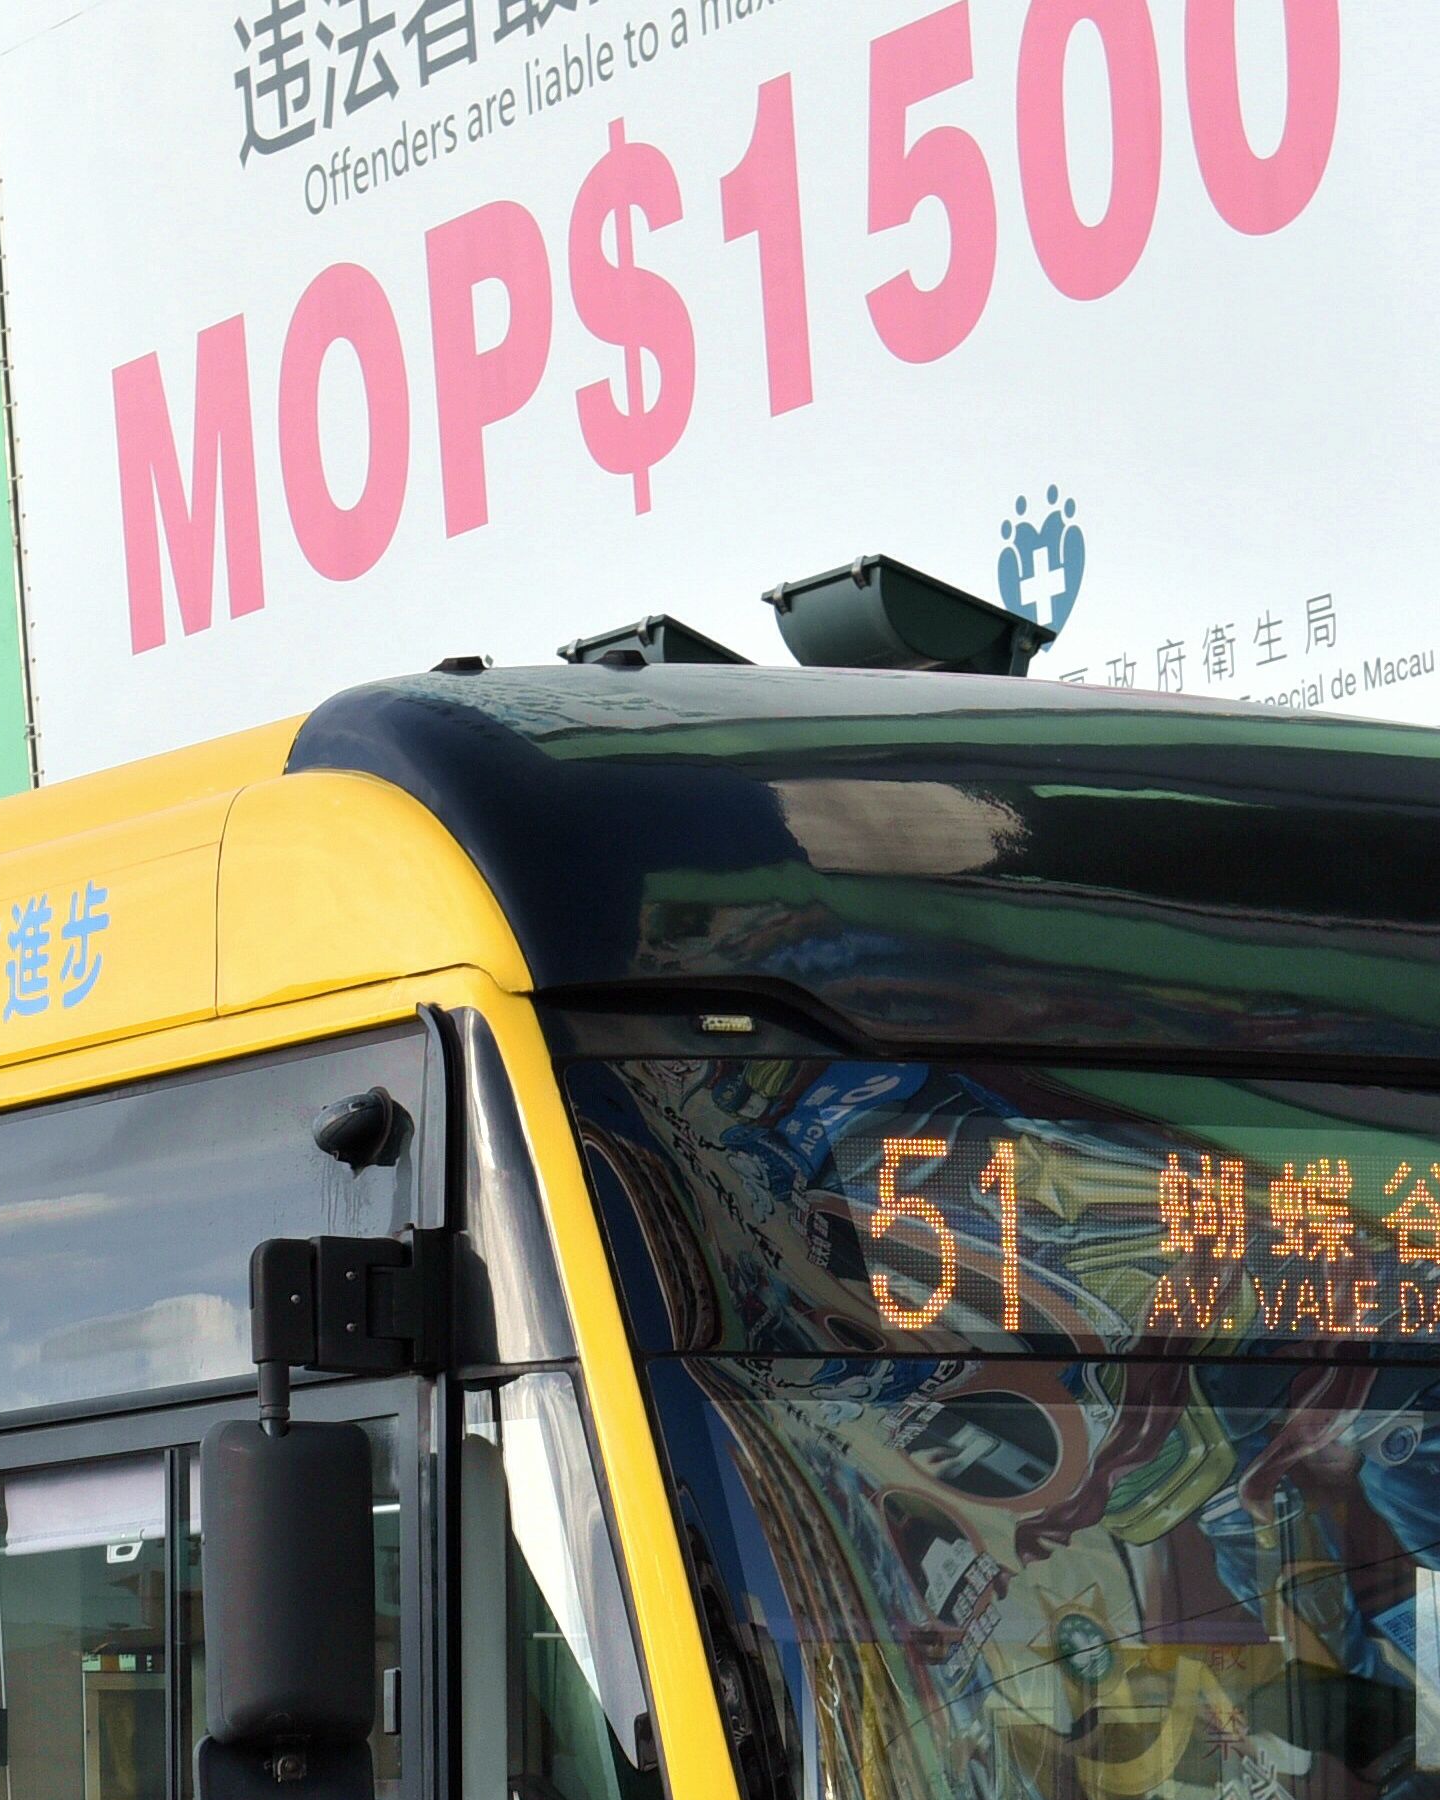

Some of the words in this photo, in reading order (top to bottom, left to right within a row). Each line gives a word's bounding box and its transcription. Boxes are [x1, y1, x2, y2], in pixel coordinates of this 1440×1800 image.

[303, 114, 458, 216] Offenders
[467, 83, 516, 142] are
[525, 30, 616, 117] liable
[623, 20, 660, 69] to
[670, 7, 689, 49] a
[113, 0, 1342, 655] MOP$1500
[1331, 666, 1357, 700] de
[1362, 649, 1436, 693] Macau
[870, 1137, 1019, 1331] 51
[1145, 1273, 1235, 1333] AV.
[1254, 1277, 1380, 1334] VALE
